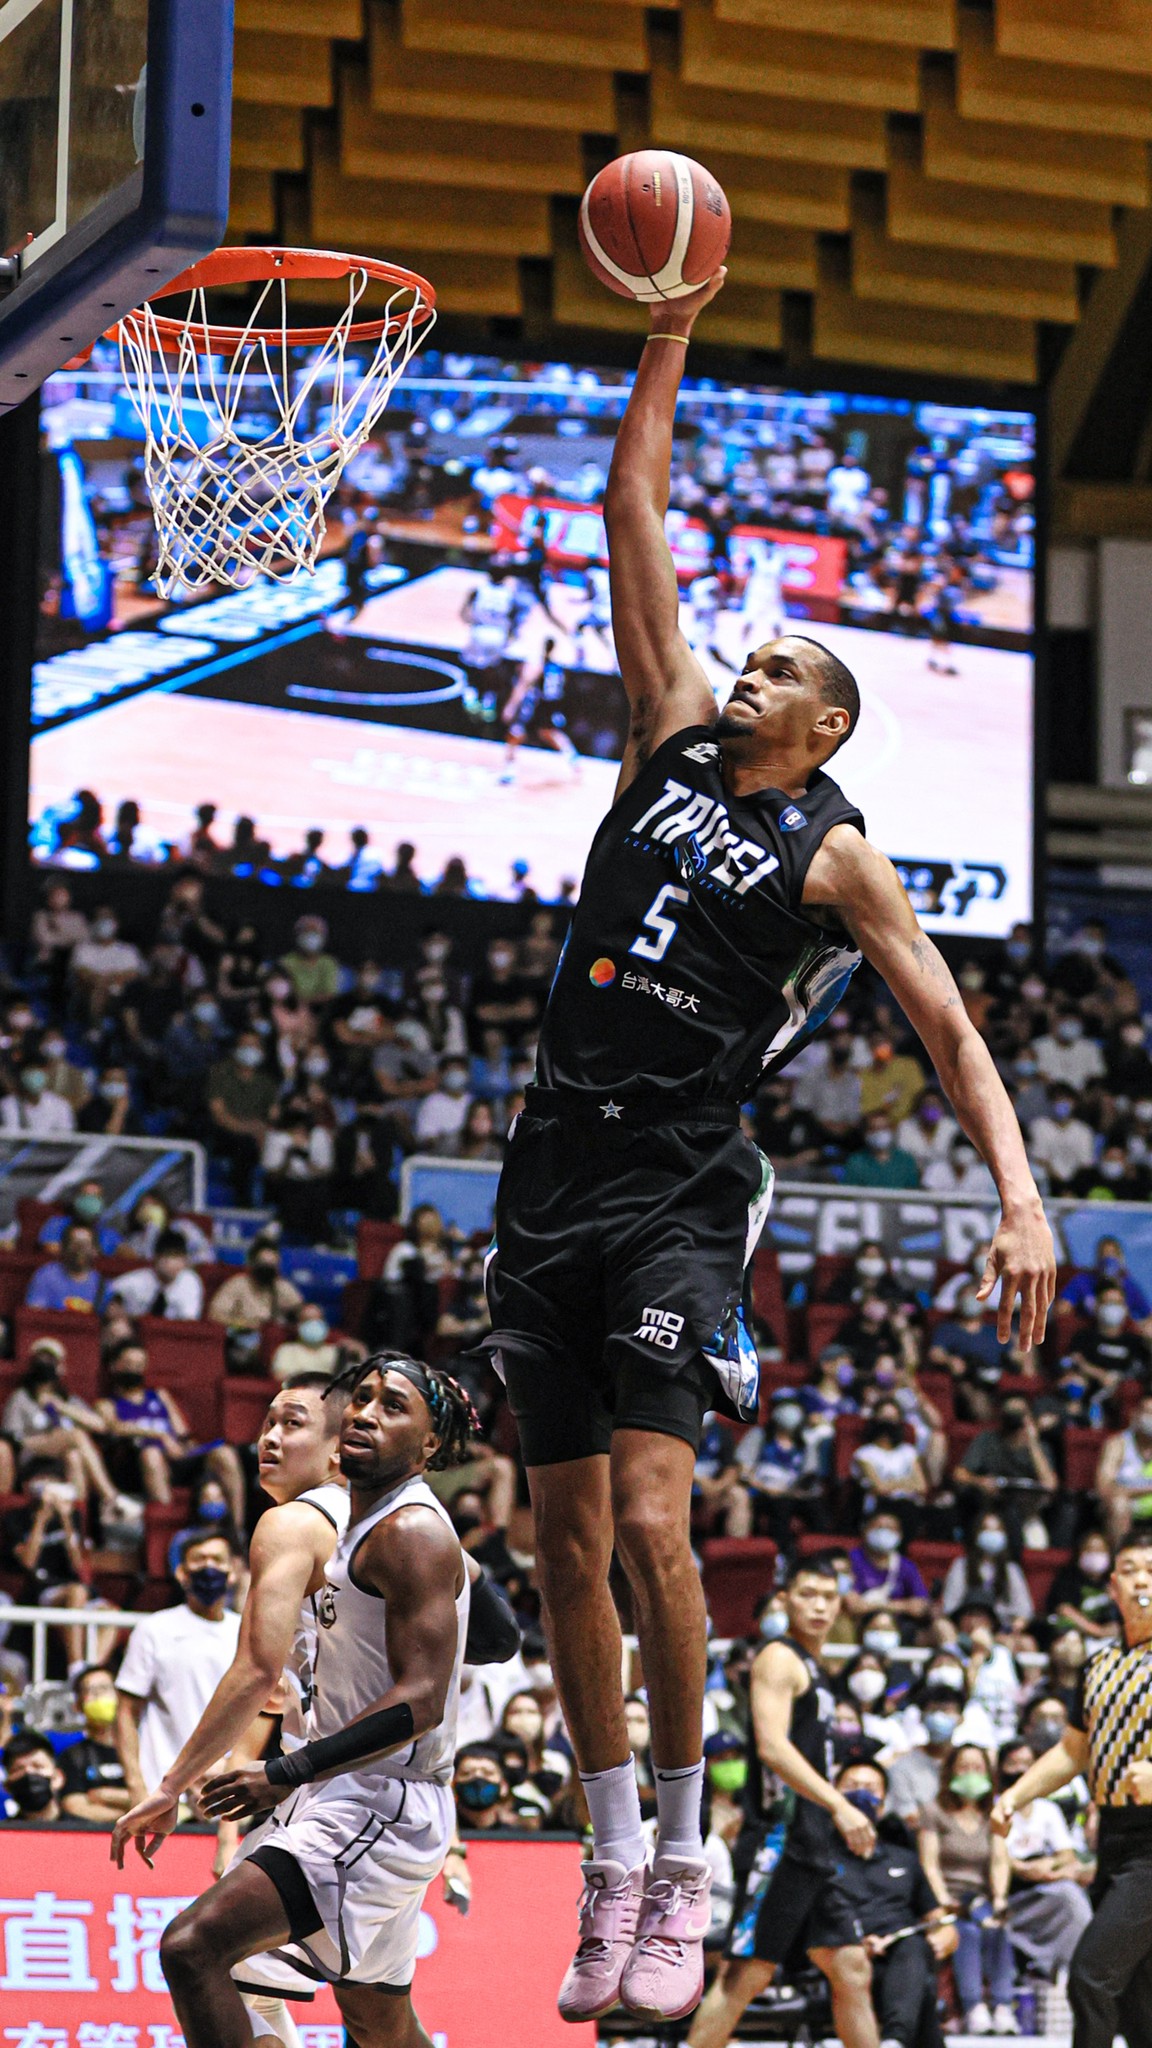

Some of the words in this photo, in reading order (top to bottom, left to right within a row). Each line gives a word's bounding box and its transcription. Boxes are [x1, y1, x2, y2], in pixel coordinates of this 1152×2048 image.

[628, 883, 690, 962] 5
[621, 971, 701, 1014] 台灣大哥大
